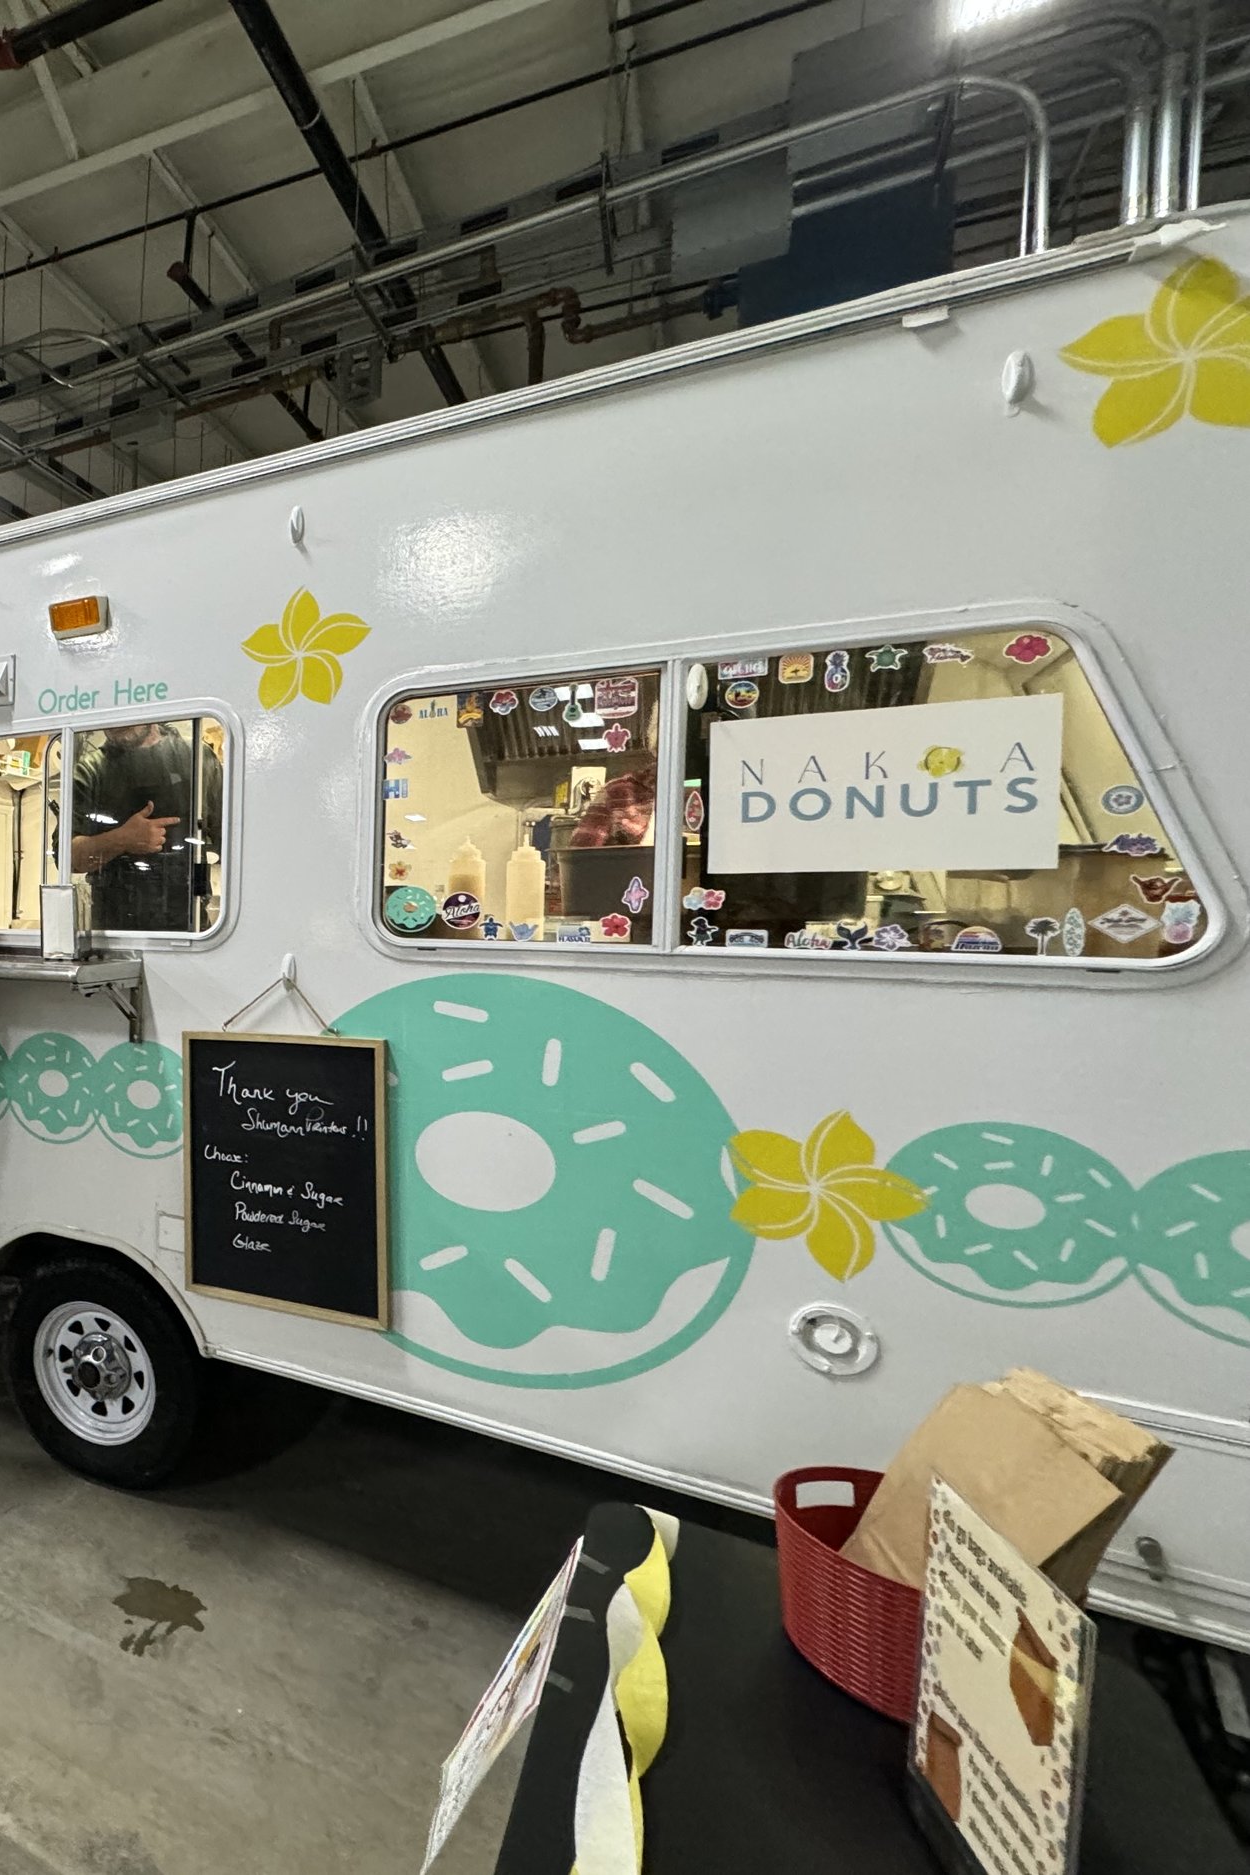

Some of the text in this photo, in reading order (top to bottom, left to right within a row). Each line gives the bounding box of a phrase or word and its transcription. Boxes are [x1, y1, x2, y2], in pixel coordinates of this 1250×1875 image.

[38, 678, 169, 715] Order Here
[741, 777, 1039, 824] DONUTS
[445, 902, 481, 919] Aloha
[785, 929, 831, 948] Aloha
[212, 1060, 334, 1116] Thank you
[234, 1201, 284, 1224] Powdered
[232, 1233, 272, 1252] Glaze
